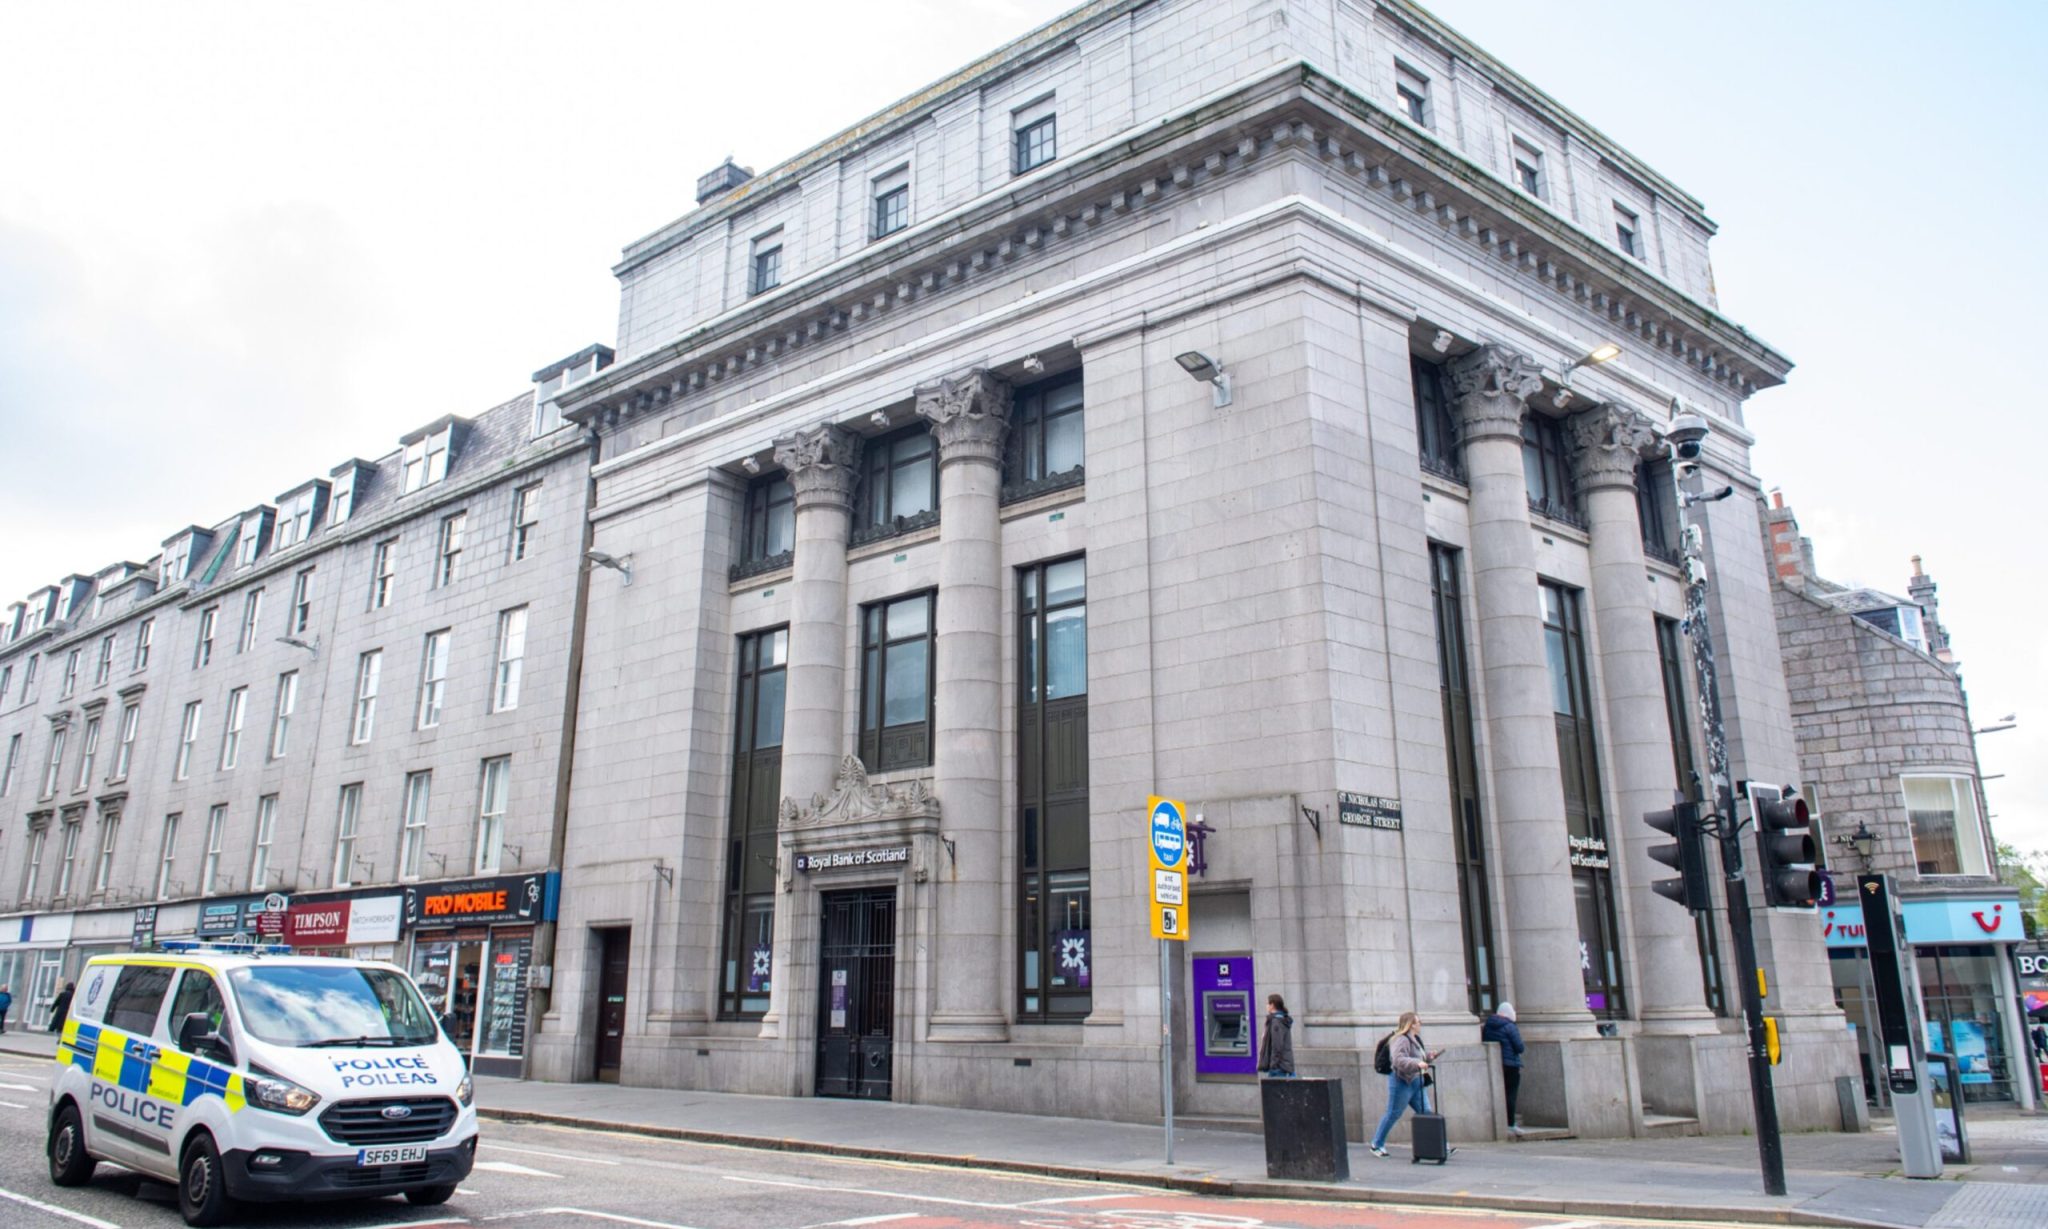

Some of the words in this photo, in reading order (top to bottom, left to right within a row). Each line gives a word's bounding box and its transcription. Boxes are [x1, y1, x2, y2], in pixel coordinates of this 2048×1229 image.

[1347, 793, 1379, 808] NICHOLAS
[1379, 799, 1401, 810] STREET
[1342, 812, 1373, 825] GEORGE
[1373, 816, 1401, 829] STREET
[1569, 834, 1589, 852] Royal
[1589, 837, 1607, 850] Bank
[808, 854, 832, 871] Royal
[832, 852, 854, 866] Bank
[854, 851, 866, 865] of
[866, 848, 907, 863] Scotland
[1571, 853, 1580, 866] of
[1580, 854, 1609, 868] Scotland
[424, 895, 453, 916] PRO
[453, 889, 508, 913] MOBILE
[295, 911, 342, 929] TIMPSON
[1837, 924, 1865, 939] TUI
[332, 1057, 430, 1072] POLICE
[341, 1073, 438, 1088] POILEAS
[90, 1082, 176, 1130] POLICE
[366, 1149, 399, 1164] SF69
[400, 1147, 425, 1161] EHJ
